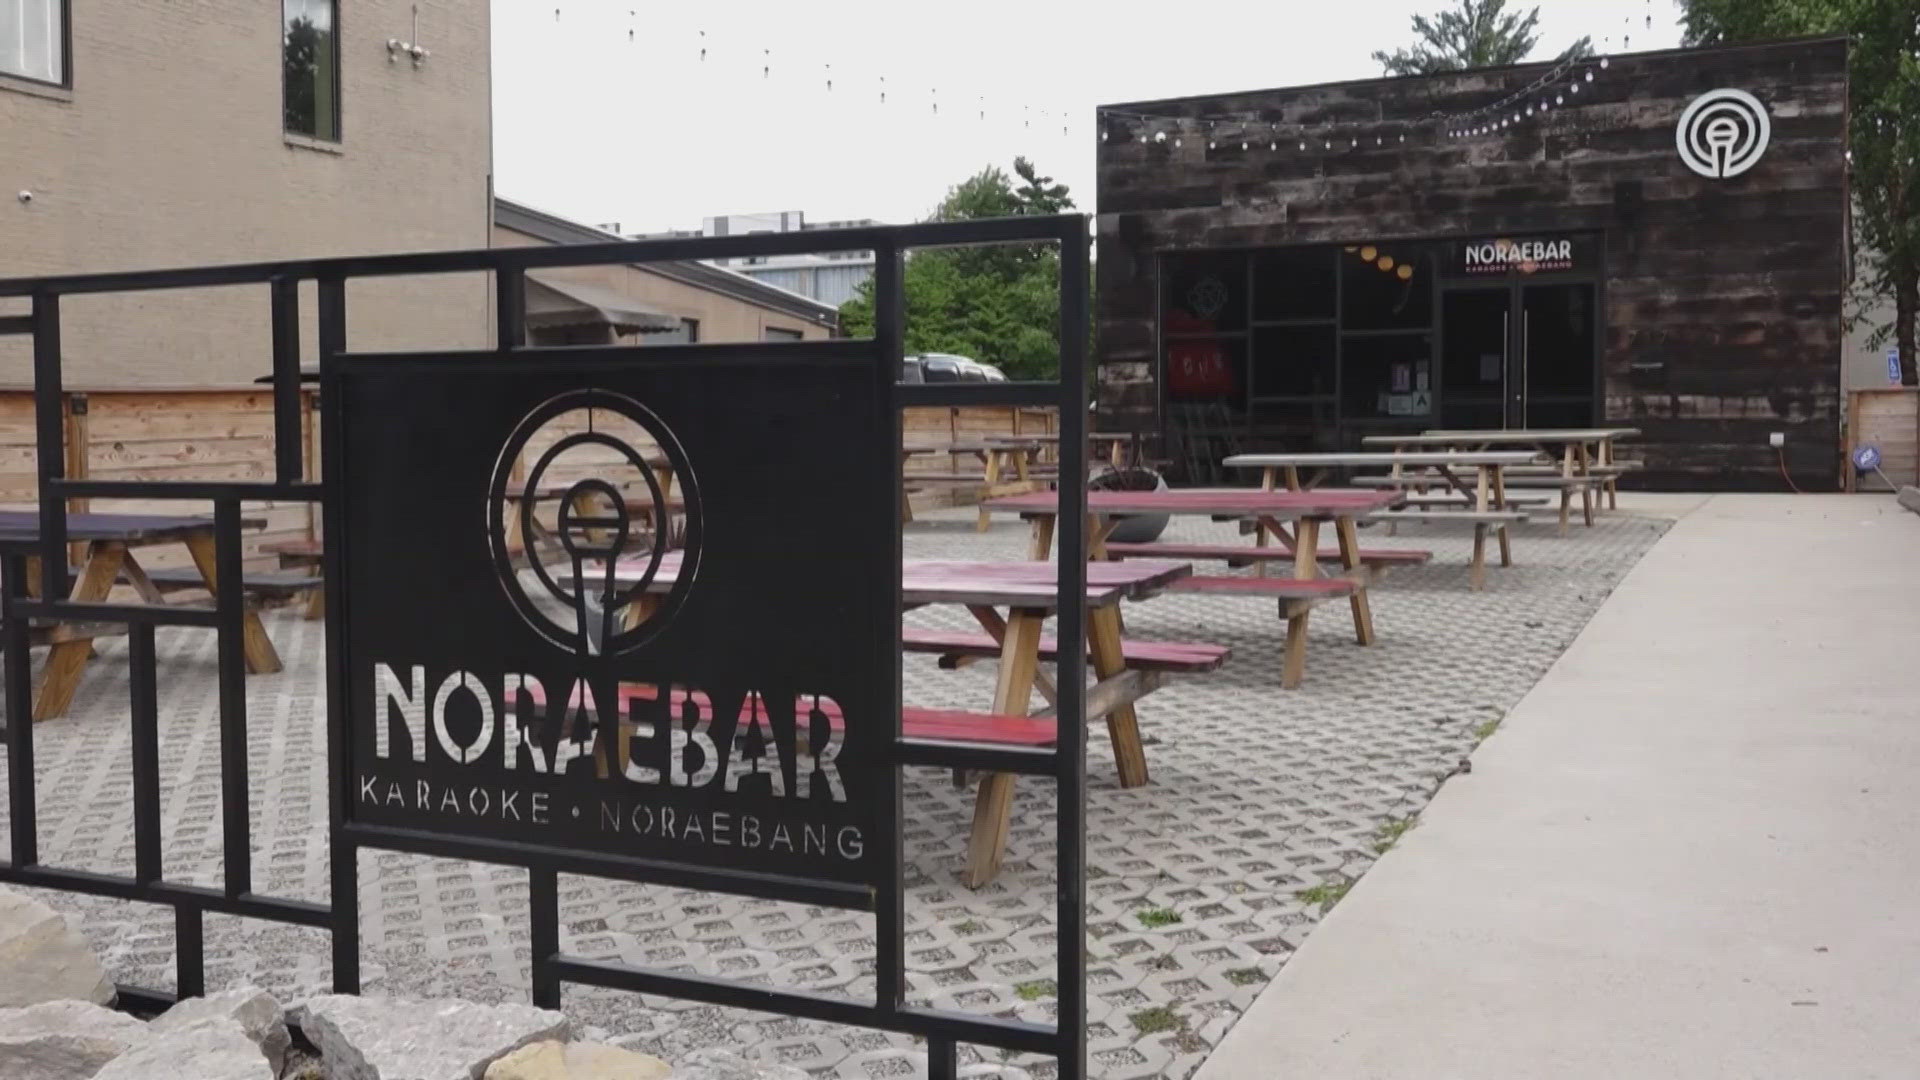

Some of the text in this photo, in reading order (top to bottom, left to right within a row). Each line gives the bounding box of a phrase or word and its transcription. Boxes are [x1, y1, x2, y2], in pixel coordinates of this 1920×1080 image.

[1465, 240, 1571, 264] NORAEBAR
[374, 662, 847, 803] NORAEBAR
[359, 774, 864, 861] KARAOKE NORAEBANG
